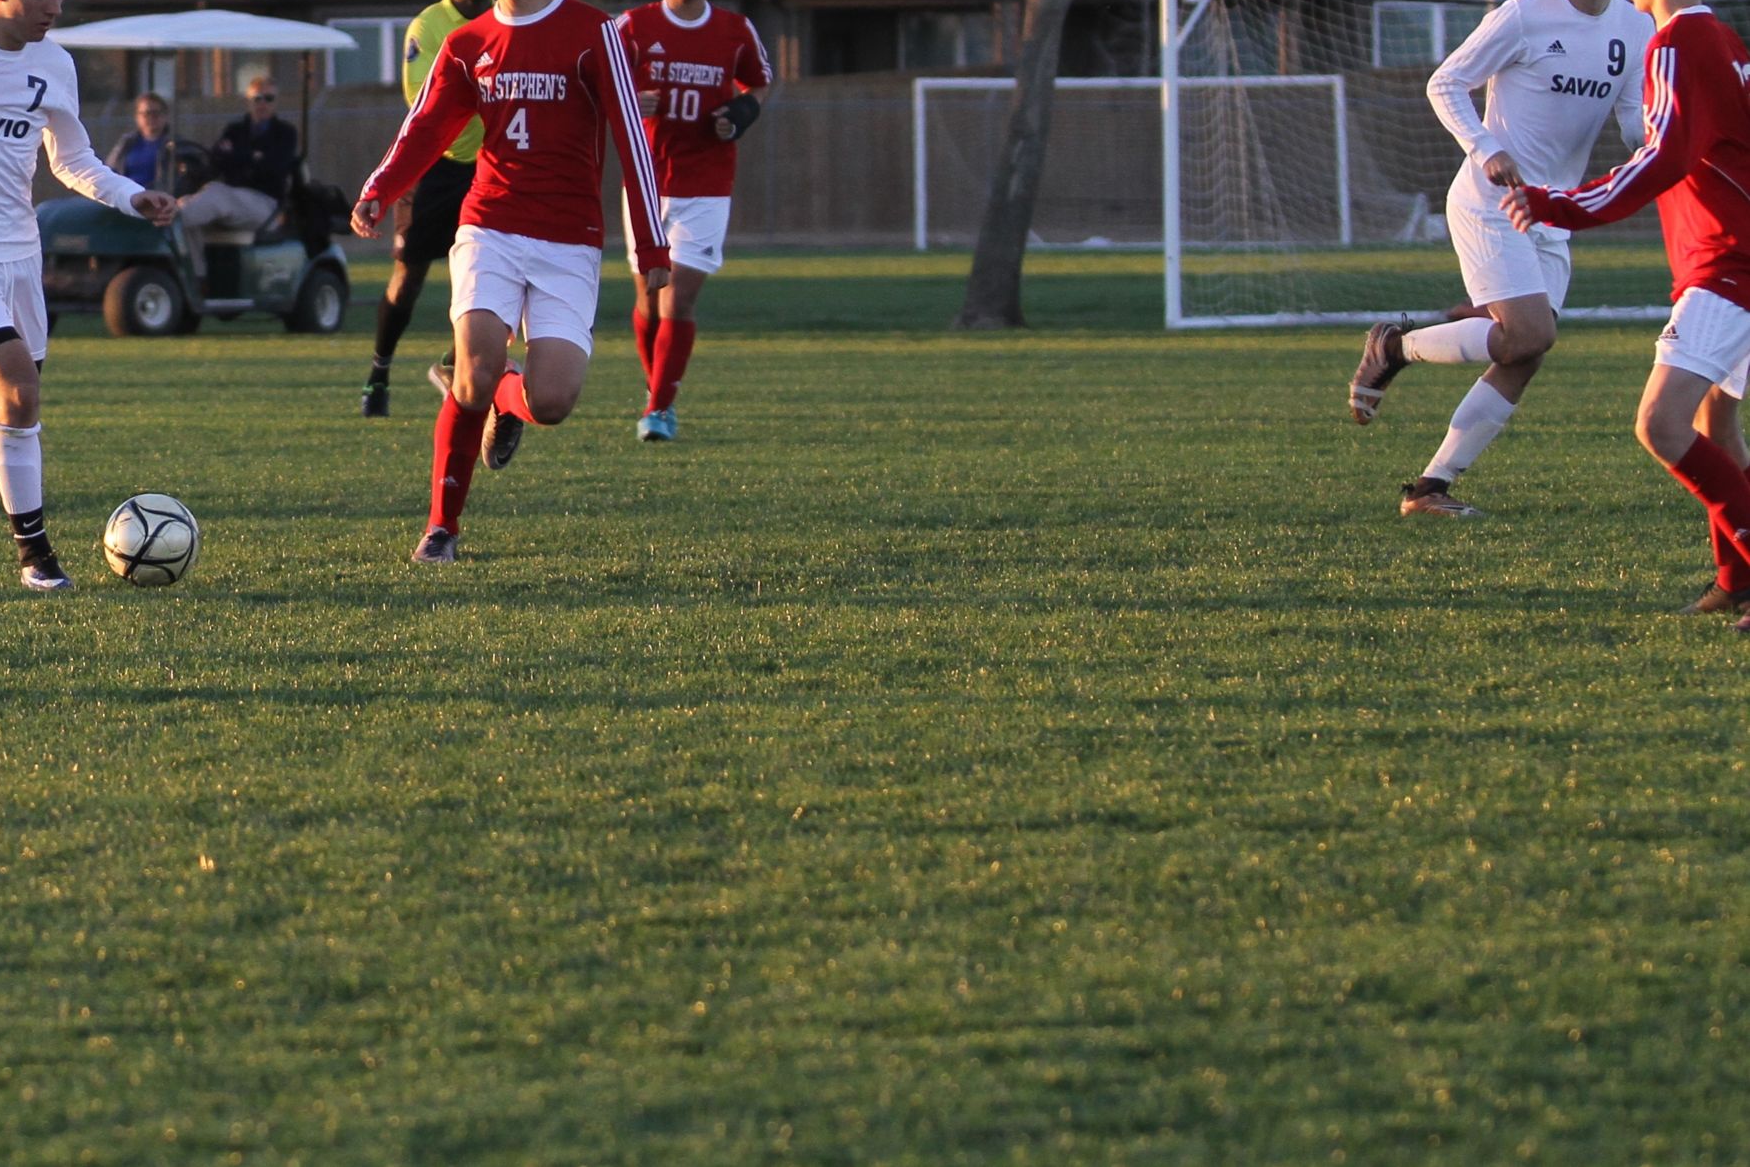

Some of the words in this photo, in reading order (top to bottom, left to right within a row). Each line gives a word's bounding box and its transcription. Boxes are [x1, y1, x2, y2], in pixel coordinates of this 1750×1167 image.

[668, 61, 725, 87] STEPHEN'S
[1607, 38, 1626, 77] 9
[26, 74, 48, 112] 7
[495, 72, 567, 101] STEPHEN'S
[1550, 74, 1612, 99] SAVIO
[667, 87, 701, 121] 10
[505, 107, 530, 150] 4
